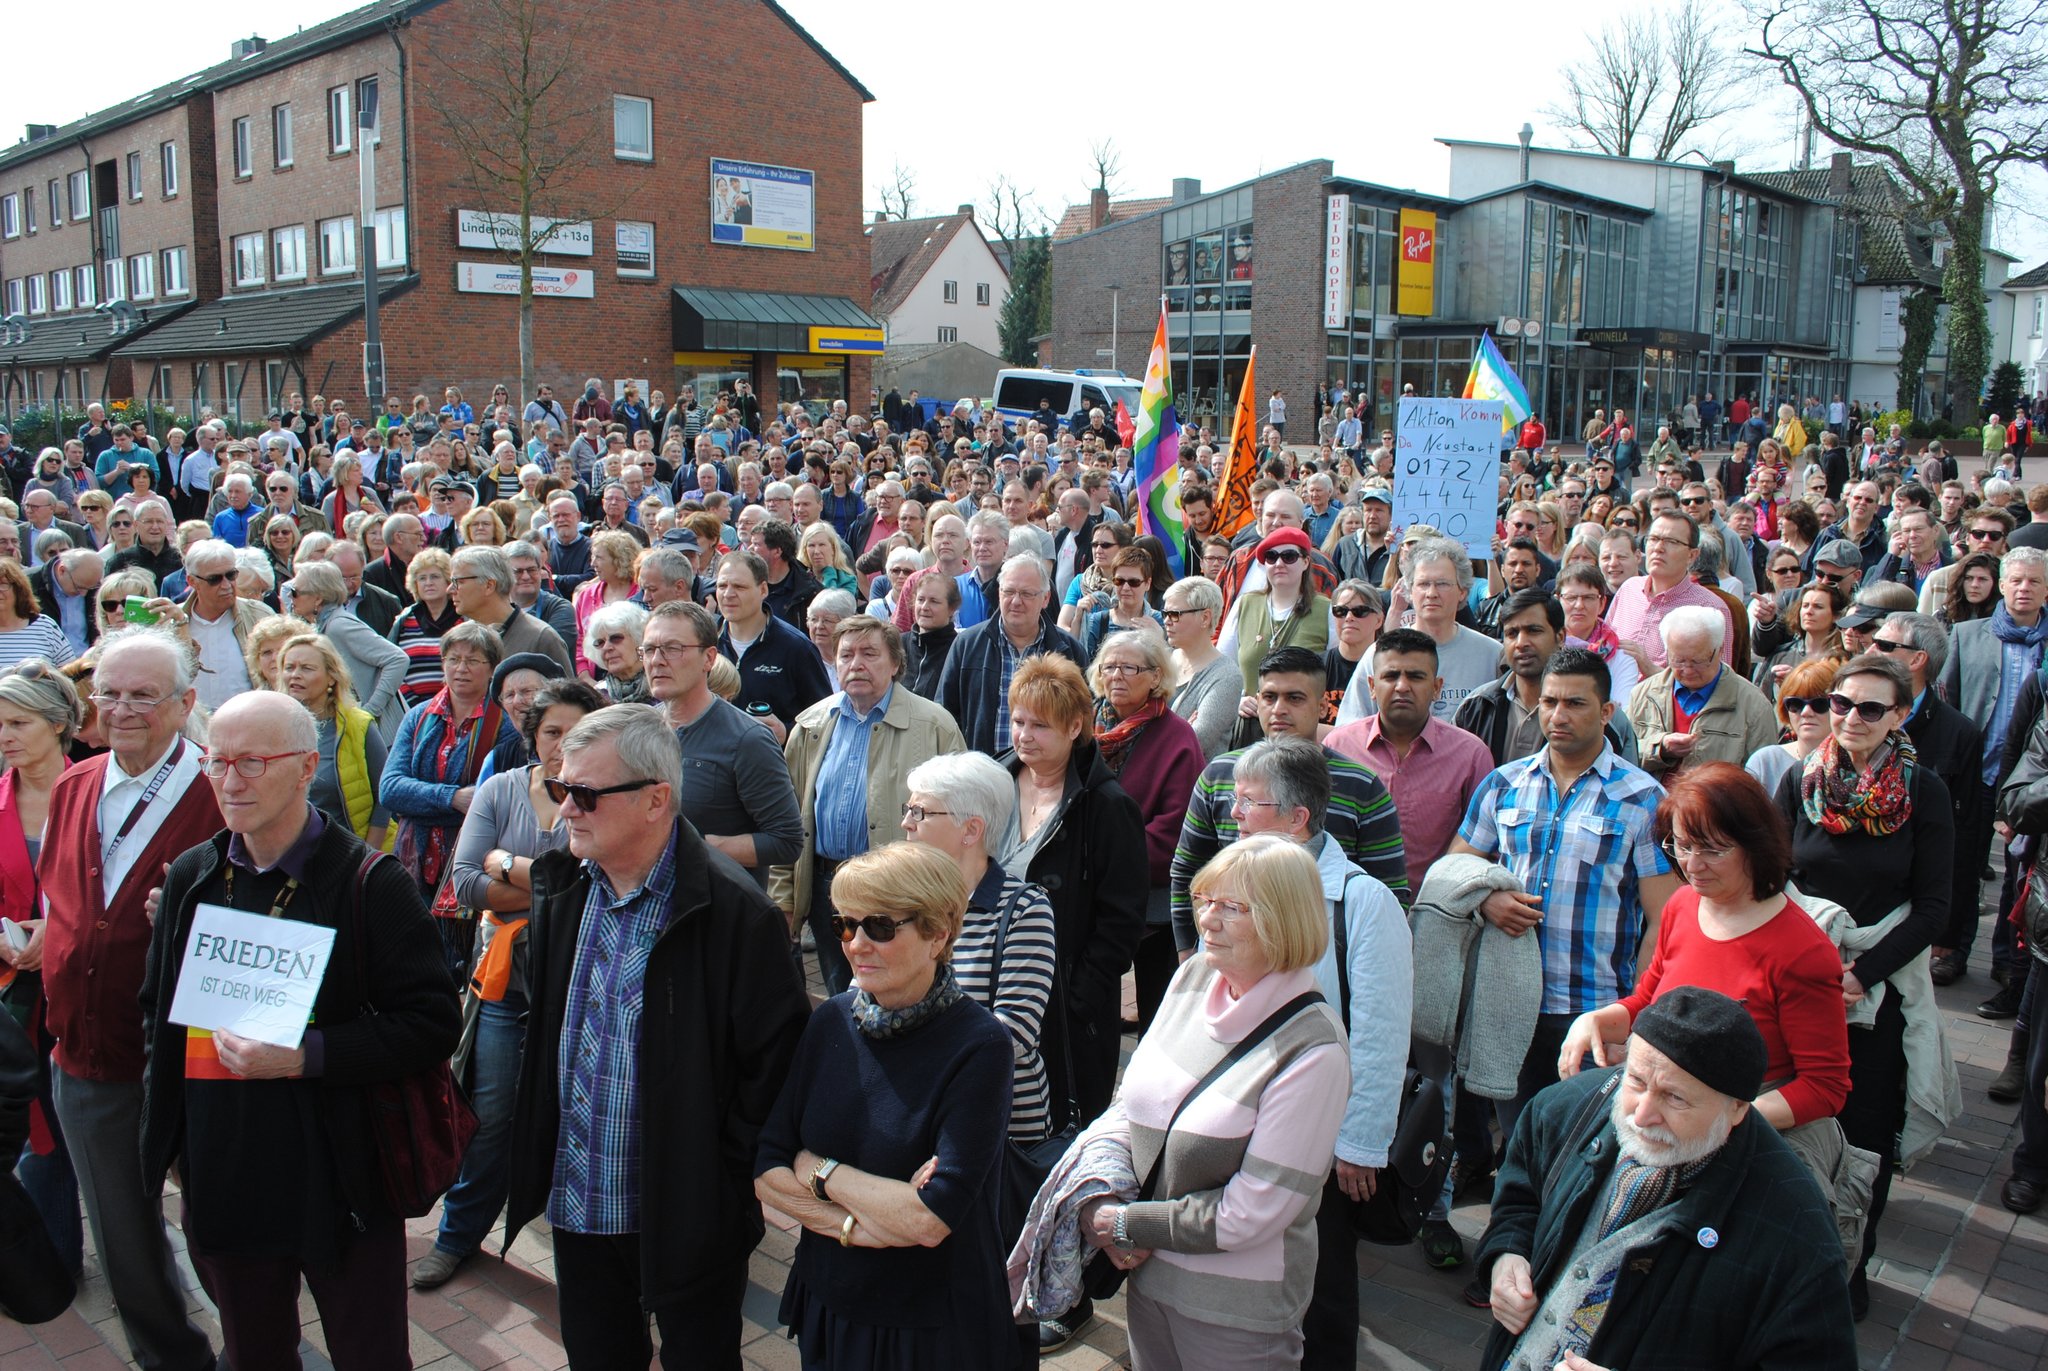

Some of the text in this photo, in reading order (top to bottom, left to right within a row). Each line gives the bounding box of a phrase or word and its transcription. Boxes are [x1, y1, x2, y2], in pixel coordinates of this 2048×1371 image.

[718, 163, 738, 173] Unsere
[738, 165, 766, 178] Erfahrung
[461, 222, 545, 242] Lindenpasge
[1331, 199, 1341, 258] HEIDE
[1404, 231, 1431, 258] Ray-Ban
[1328, 265, 1339, 325] OPTIK
[1583, 331, 1628, 343] CANTINELLA
[1404, 404, 1502, 429] Aktion Komm
[1398, 433, 1495, 455] Da Neustart
[194, 933, 315, 979] FRIEDEN
[200, 975, 288, 1008] IST DER WEG
[1600, 1074, 1619, 1094] SONY
